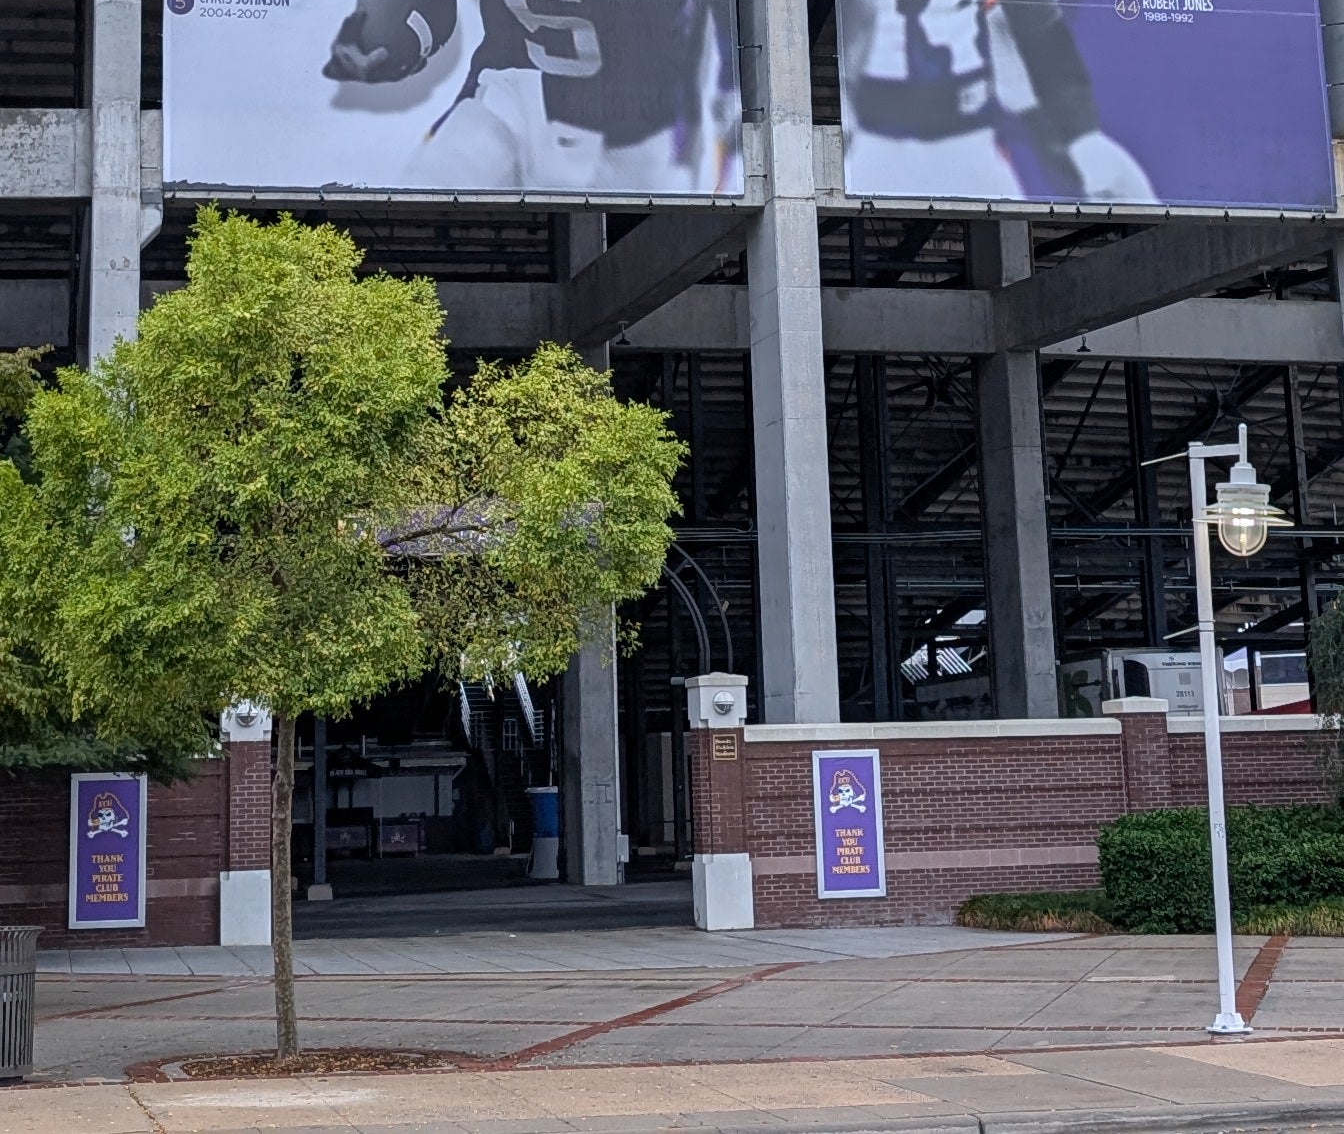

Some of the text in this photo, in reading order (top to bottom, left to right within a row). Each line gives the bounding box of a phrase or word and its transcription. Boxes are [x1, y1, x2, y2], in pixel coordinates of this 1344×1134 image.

[199, 7, 268, 19] 2004-2007
[1143, 11, 1194, 23] 1988-1992
[835, 829, 864, 838] THANK
[842, 838, 858, 846] YOU
[837, 847, 864, 856] PIRATE
[91, 854, 124, 864] THANK
[840, 856, 862, 865] CLUB
[99, 864, 117, 873] YOU
[832, 865, 870, 875] MEMBERS
[92, 873, 124, 883] PIRATE
[96, 883, 119, 892] CLUB
[86, 892, 129, 903] MEMBERS
